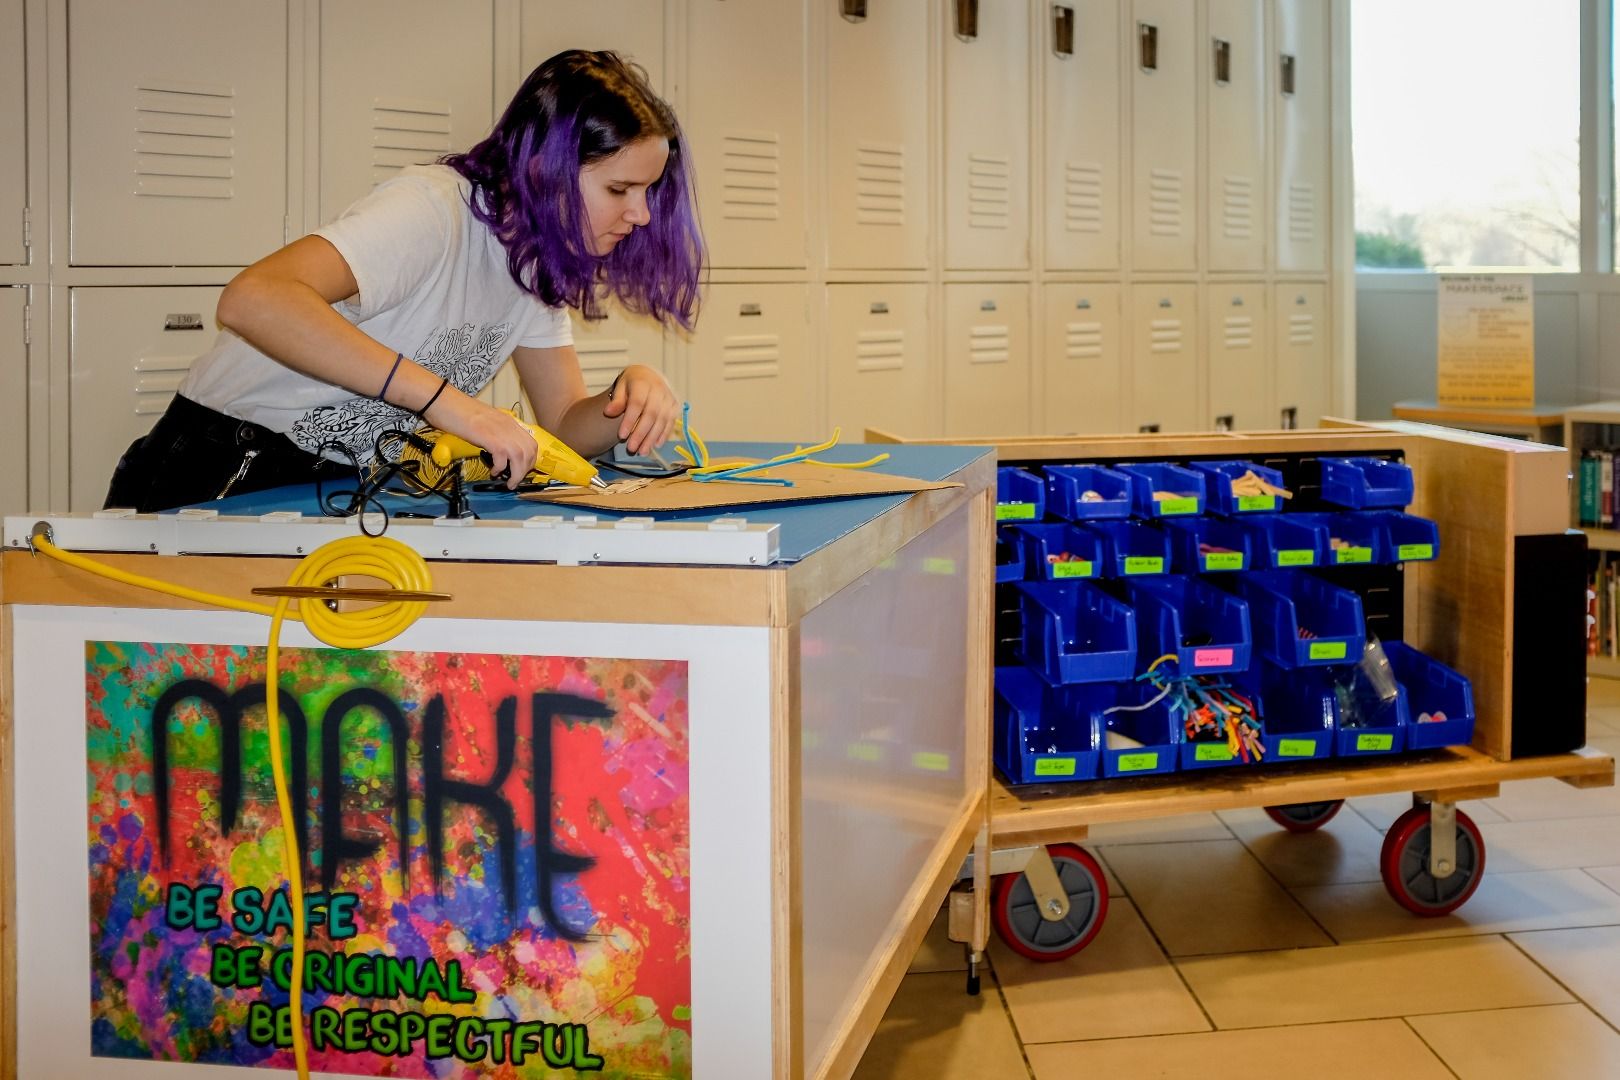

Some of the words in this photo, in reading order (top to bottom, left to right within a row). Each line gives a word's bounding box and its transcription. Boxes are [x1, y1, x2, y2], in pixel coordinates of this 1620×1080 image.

[152, 679, 616, 942] MAKE
[167, 883, 223, 931] BE
[231, 886, 359, 939] SAFE
[211, 943, 263, 988] BE
[271, 949, 477, 1004] ORIGINAL
[250, 1001, 294, 1049] BE
[311, 1006, 604, 1071] RESPECTFUL
